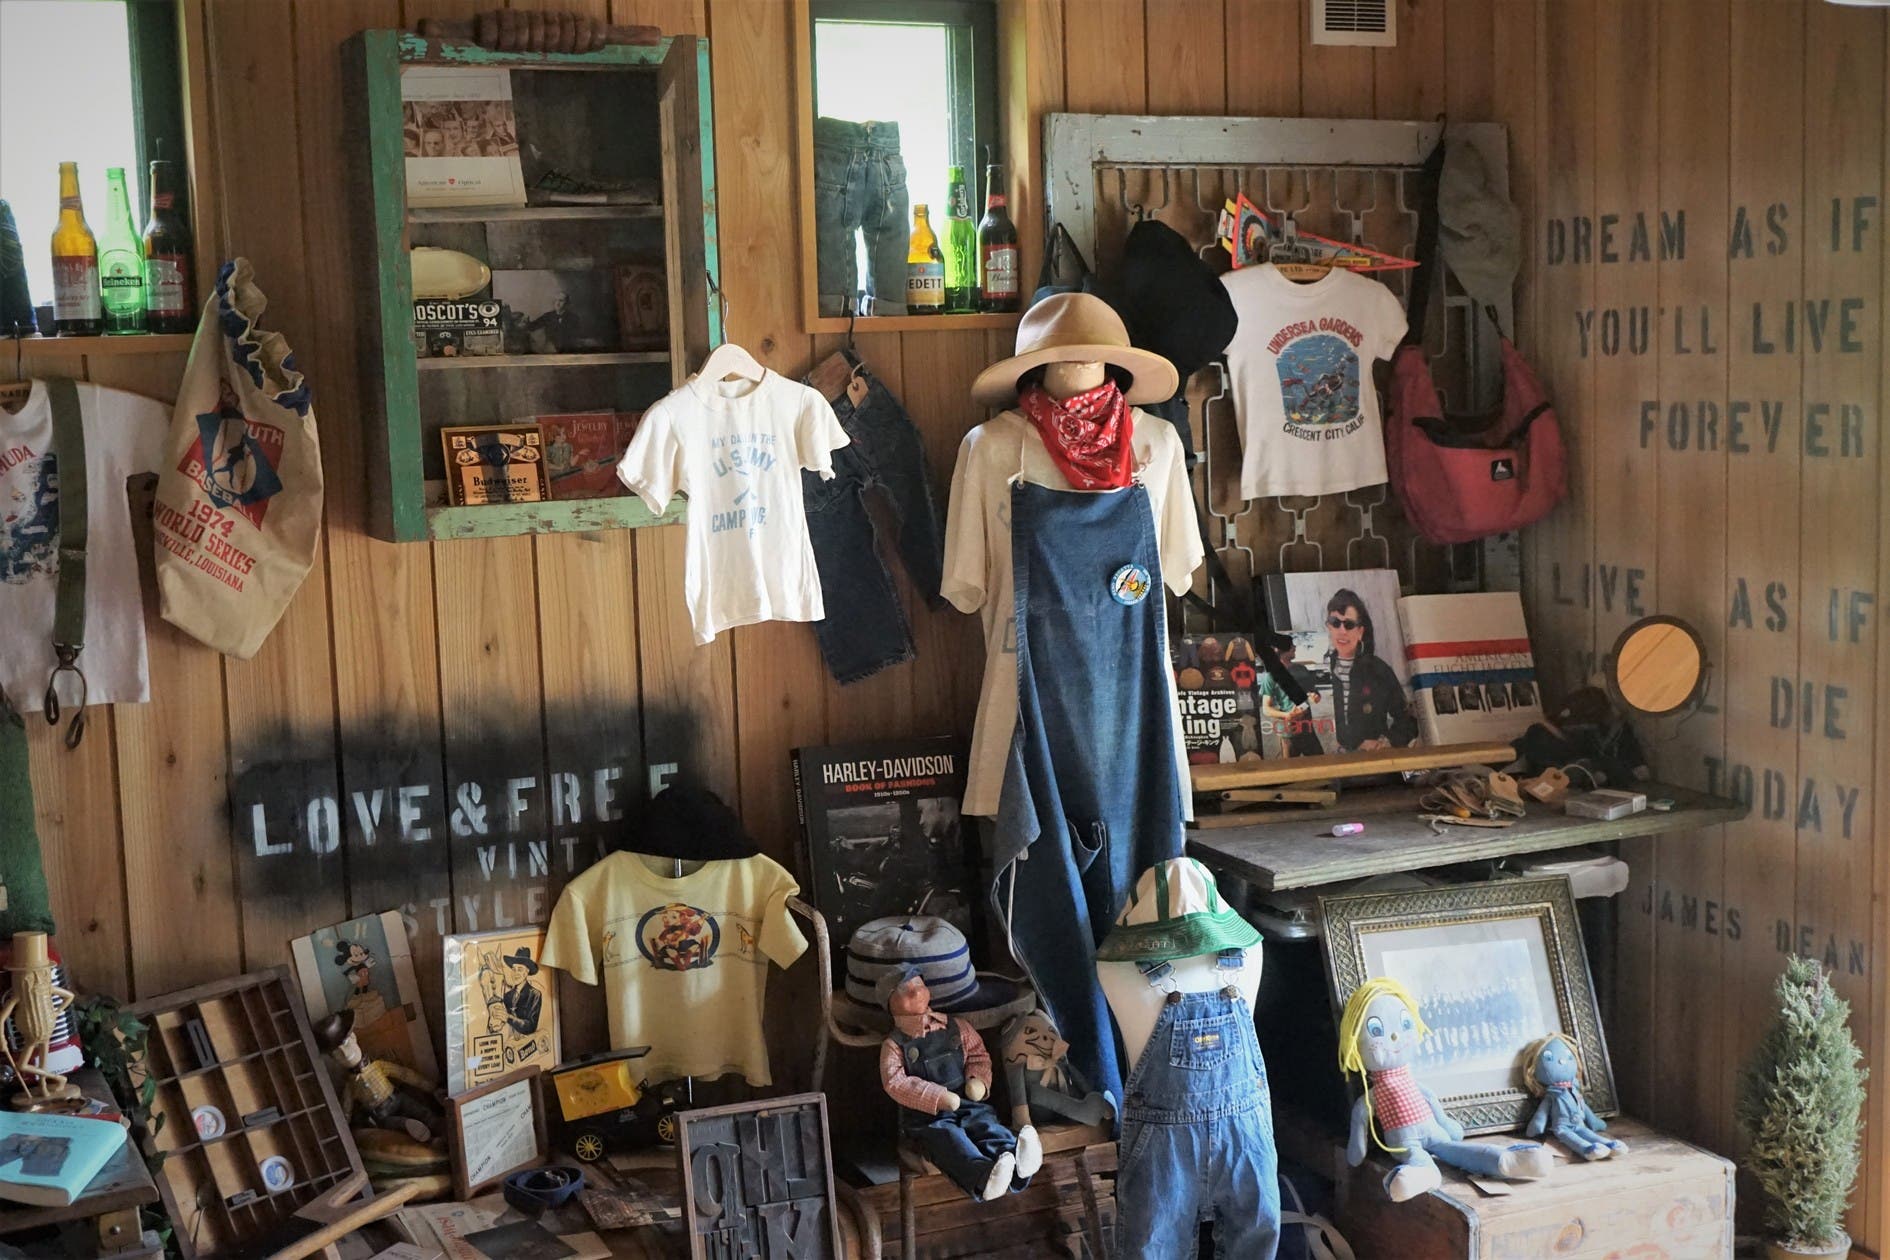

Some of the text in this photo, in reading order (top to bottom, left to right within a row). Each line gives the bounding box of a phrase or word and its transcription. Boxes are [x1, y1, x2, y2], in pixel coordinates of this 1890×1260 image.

[1547, 196, 1877, 266] DREAM AS IF
[414, 303, 478, 320] OSCOT'S
[483, 318, 498, 327] 94
[1575, 297, 1866, 358] YOU'LL LIVE
[1266, 317, 1364, 355] UNDERSEA GARDENS
[248, 425, 284, 446] UTH
[1283, 422, 1321, 441] CRESCENT
[1325, 428, 1344, 440] CITY
[1639, 400, 1865, 458] FOREVER
[154, 501, 256, 576] WORLD SERIES
[187, 500, 235, 539] 1974
[195, 553, 244, 593] LOUISIANA
[1552, 562, 1874, 644] LIVE AS IF
[1178, 695, 1237, 718] ntage
[1770, 675, 1849, 740] DIE
[823, 754, 954, 784] HARLEY-DAVIDSON
[845, 778, 936, 792] BOOK OF FASHIONS
[1703, 754, 1860, 840] TODAY
[477, 836, 600, 881] VINT
[402, 886, 547, 937] STYLE
[1641, 884, 1865, 977] JAMES DEAN
[483, 1097, 506, 1111] CHAMPION
[470, 1156, 491, 1181] CHAMPION
